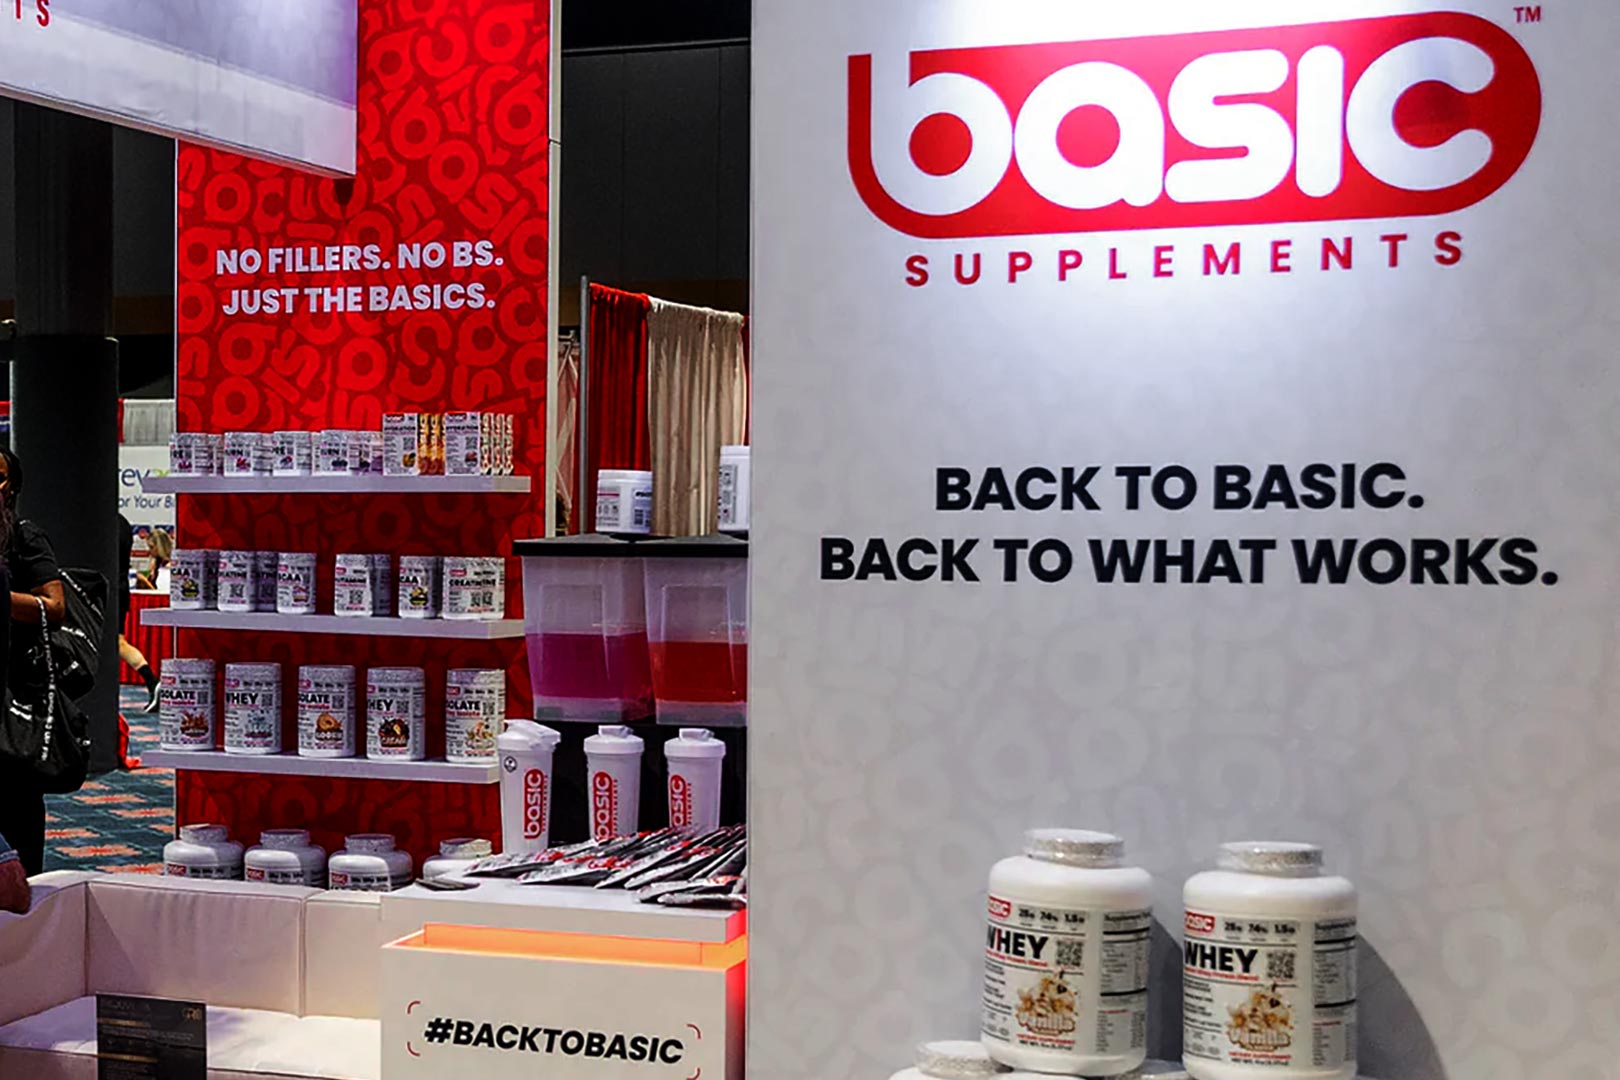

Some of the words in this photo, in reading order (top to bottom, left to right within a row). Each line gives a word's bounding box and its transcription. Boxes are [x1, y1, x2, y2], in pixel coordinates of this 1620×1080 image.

[1515, 6, 1543, 23] TM
[866, 34, 1497, 217] basic
[216, 248, 262, 275] NO
[268, 244, 391, 273] FILLERS.
[398, 242, 446, 269] NO
[453, 240, 504, 267] BS.
[905, 231, 1463, 288] SUPPLEMENTS
[223, 288, 299, 315] JUST
[304, 286, 363, 313] THE
[369, 283, 496, 312] BASICS.
[935, 466, 1101, 512] BACK
[1115, 466, 1198, 511] TO
[1212, 463, 1426, 511] BASIC.
[820, 536, 981, 581] BACK
[994, 537, 1073, 584] TO
[1087, 538, 1277, 584] WHAT
[1291, 536, 1559, 586] WORKS.
[523, 773, 542, 838] basic
[424, 1017, 685, 1065] #BACKTOBASIC
